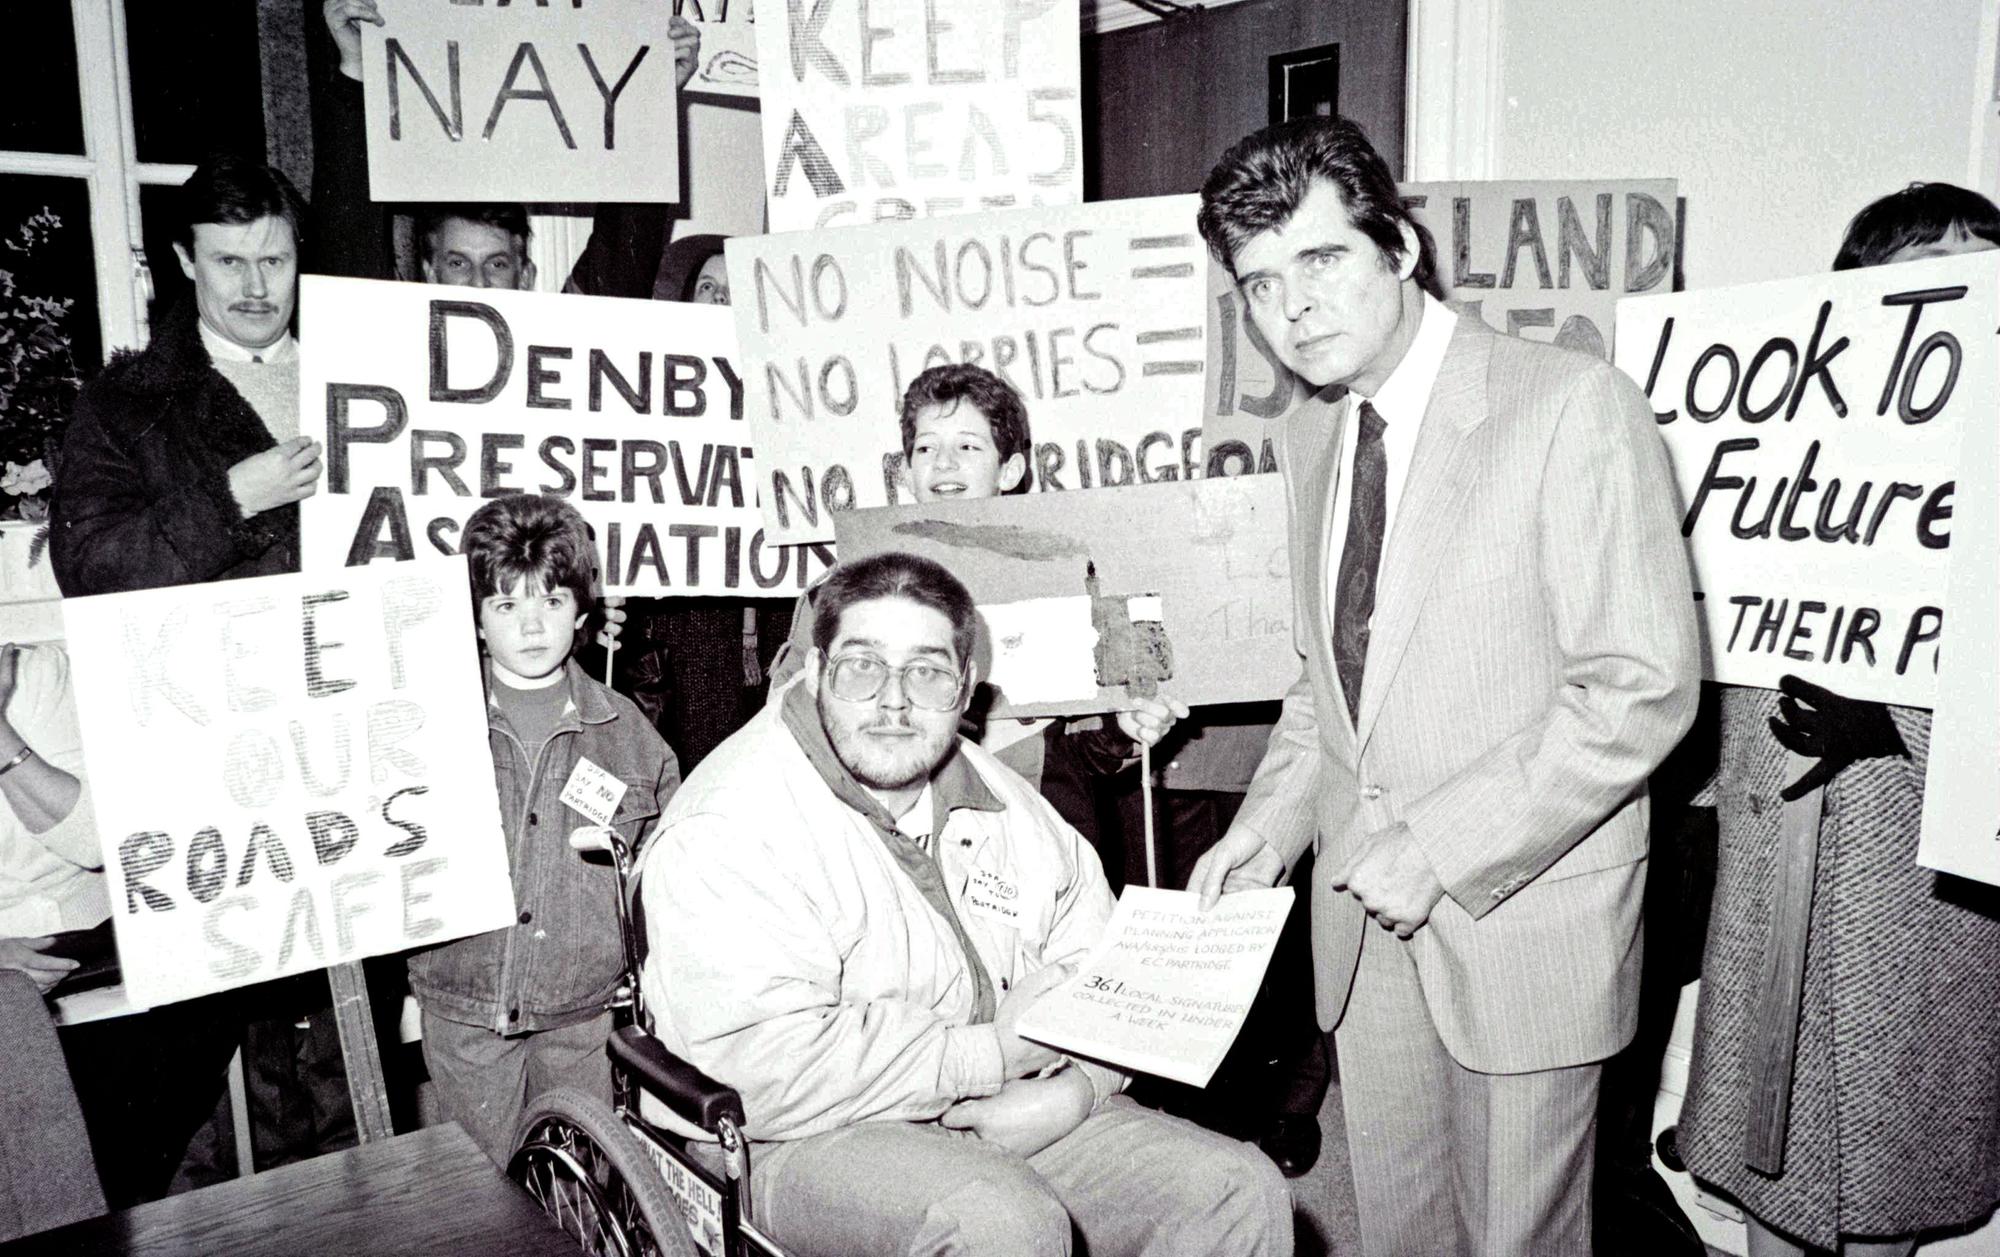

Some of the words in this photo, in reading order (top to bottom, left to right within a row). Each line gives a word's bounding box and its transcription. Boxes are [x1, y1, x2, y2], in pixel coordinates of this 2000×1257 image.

[385, 38, 650, 150] NAY
[754, 252, 848, 333] NO
[894, 229, 1102, 318] NOISE
[428, 299, 745, 422] DENBY
[764, 354, 859, 420] NO
[770, 464, 857, 528] NO
[119, 575, 443, 728] KEEP
[1728, 595, 1881, 669] THEIR
[223, 699, 428, 809] OUR
[202, 856, 449, 980] SAFE
[1083, 975, 1125, 995] 361
